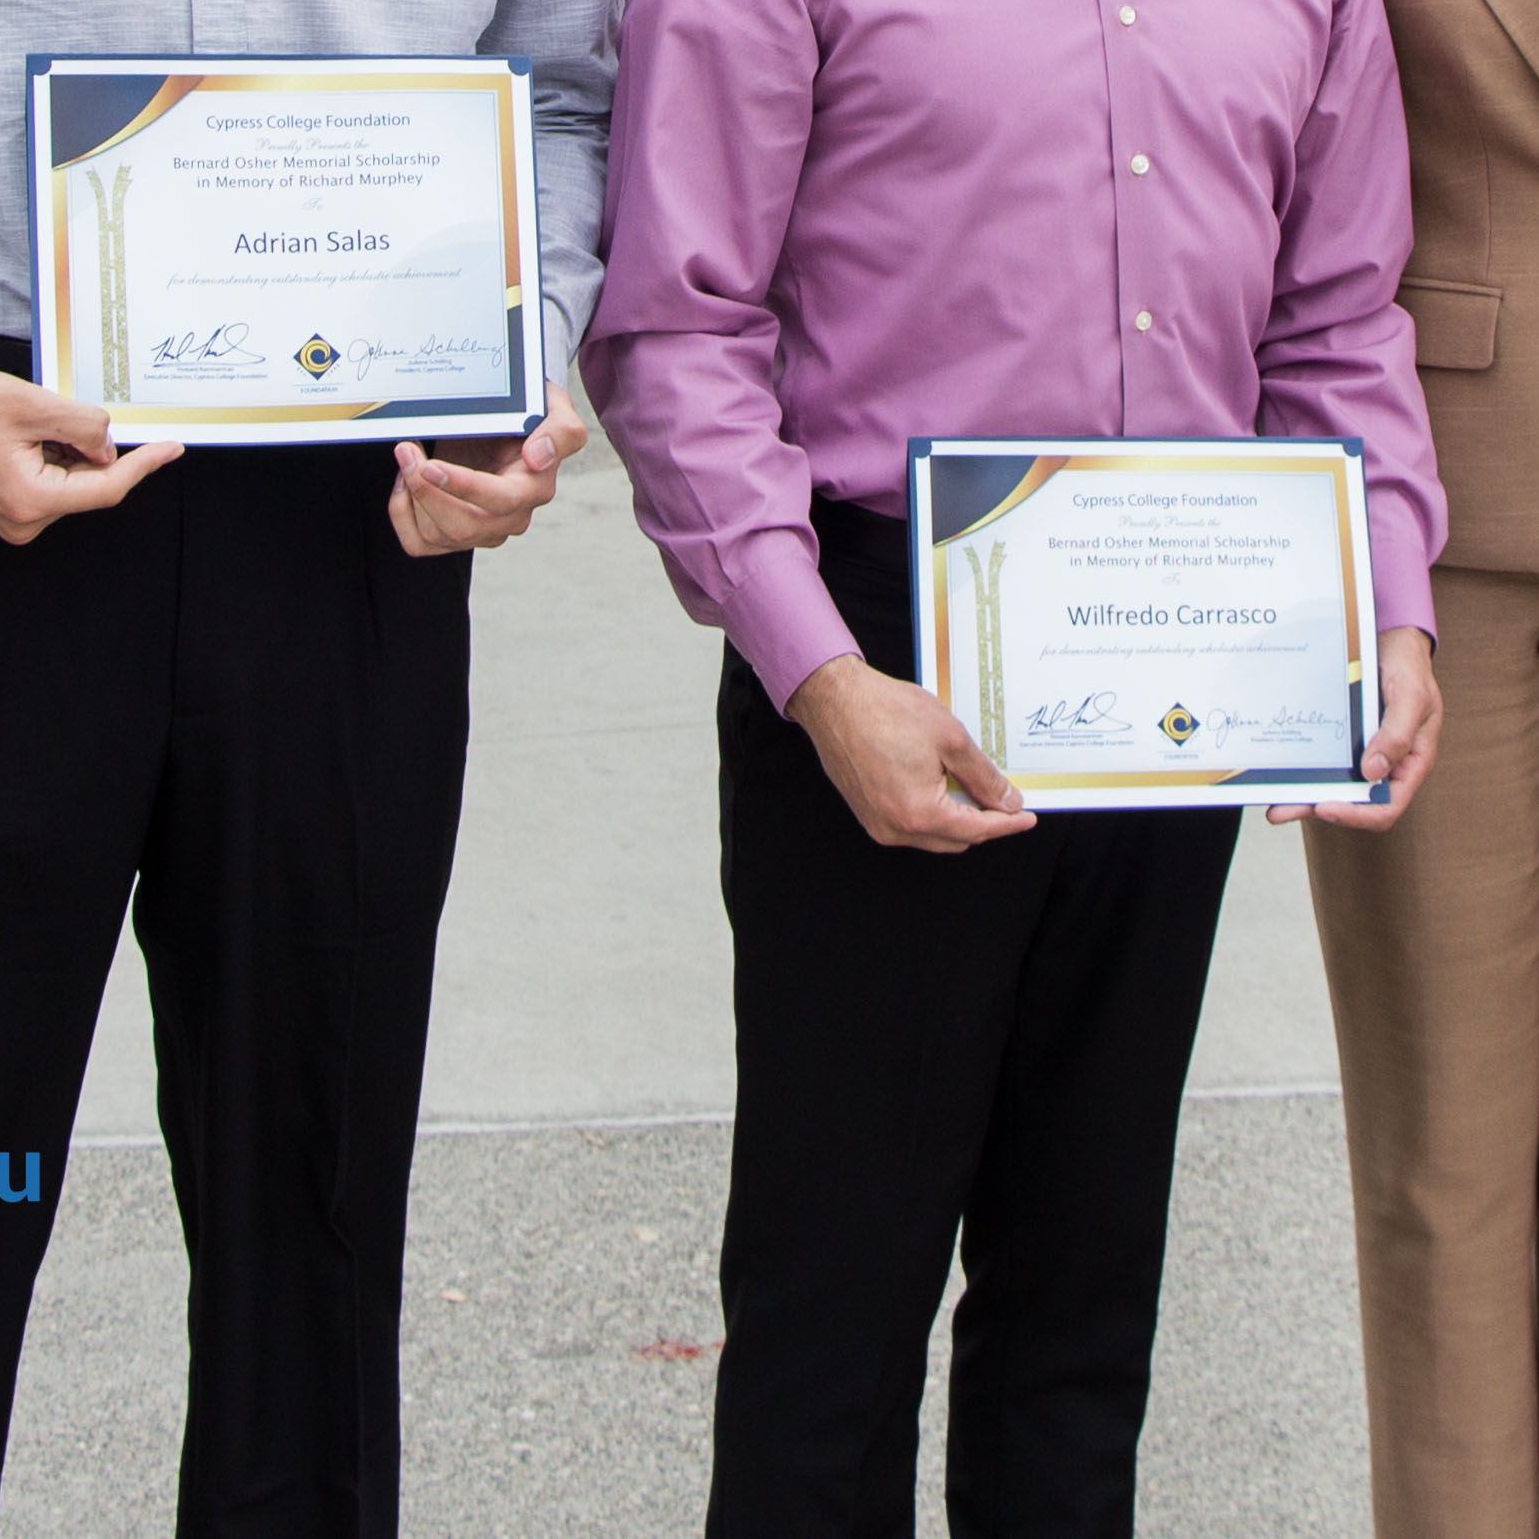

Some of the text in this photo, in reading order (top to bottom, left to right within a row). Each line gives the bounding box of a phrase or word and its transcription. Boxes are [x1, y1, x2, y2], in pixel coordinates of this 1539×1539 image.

[206, 113, 410, 132] Cypress College Foundation
[173, 152, 440, 170] Bernard Osher Memorial Scholarship
[197, 171, 423, 190] in Memory of Richard Murphey
[234, 229, 390, 254] Adrian Salas
[1072, 493, 1258, 510] Cypress College Foundation
[1048, 535, 1290, 550] Bernard Osher Memorial Scholarship
[1069, 553, 1275, 569] in Memory of Richard Murphey
[1067, 604, 1277, 626] Wilfredo Carrasco
